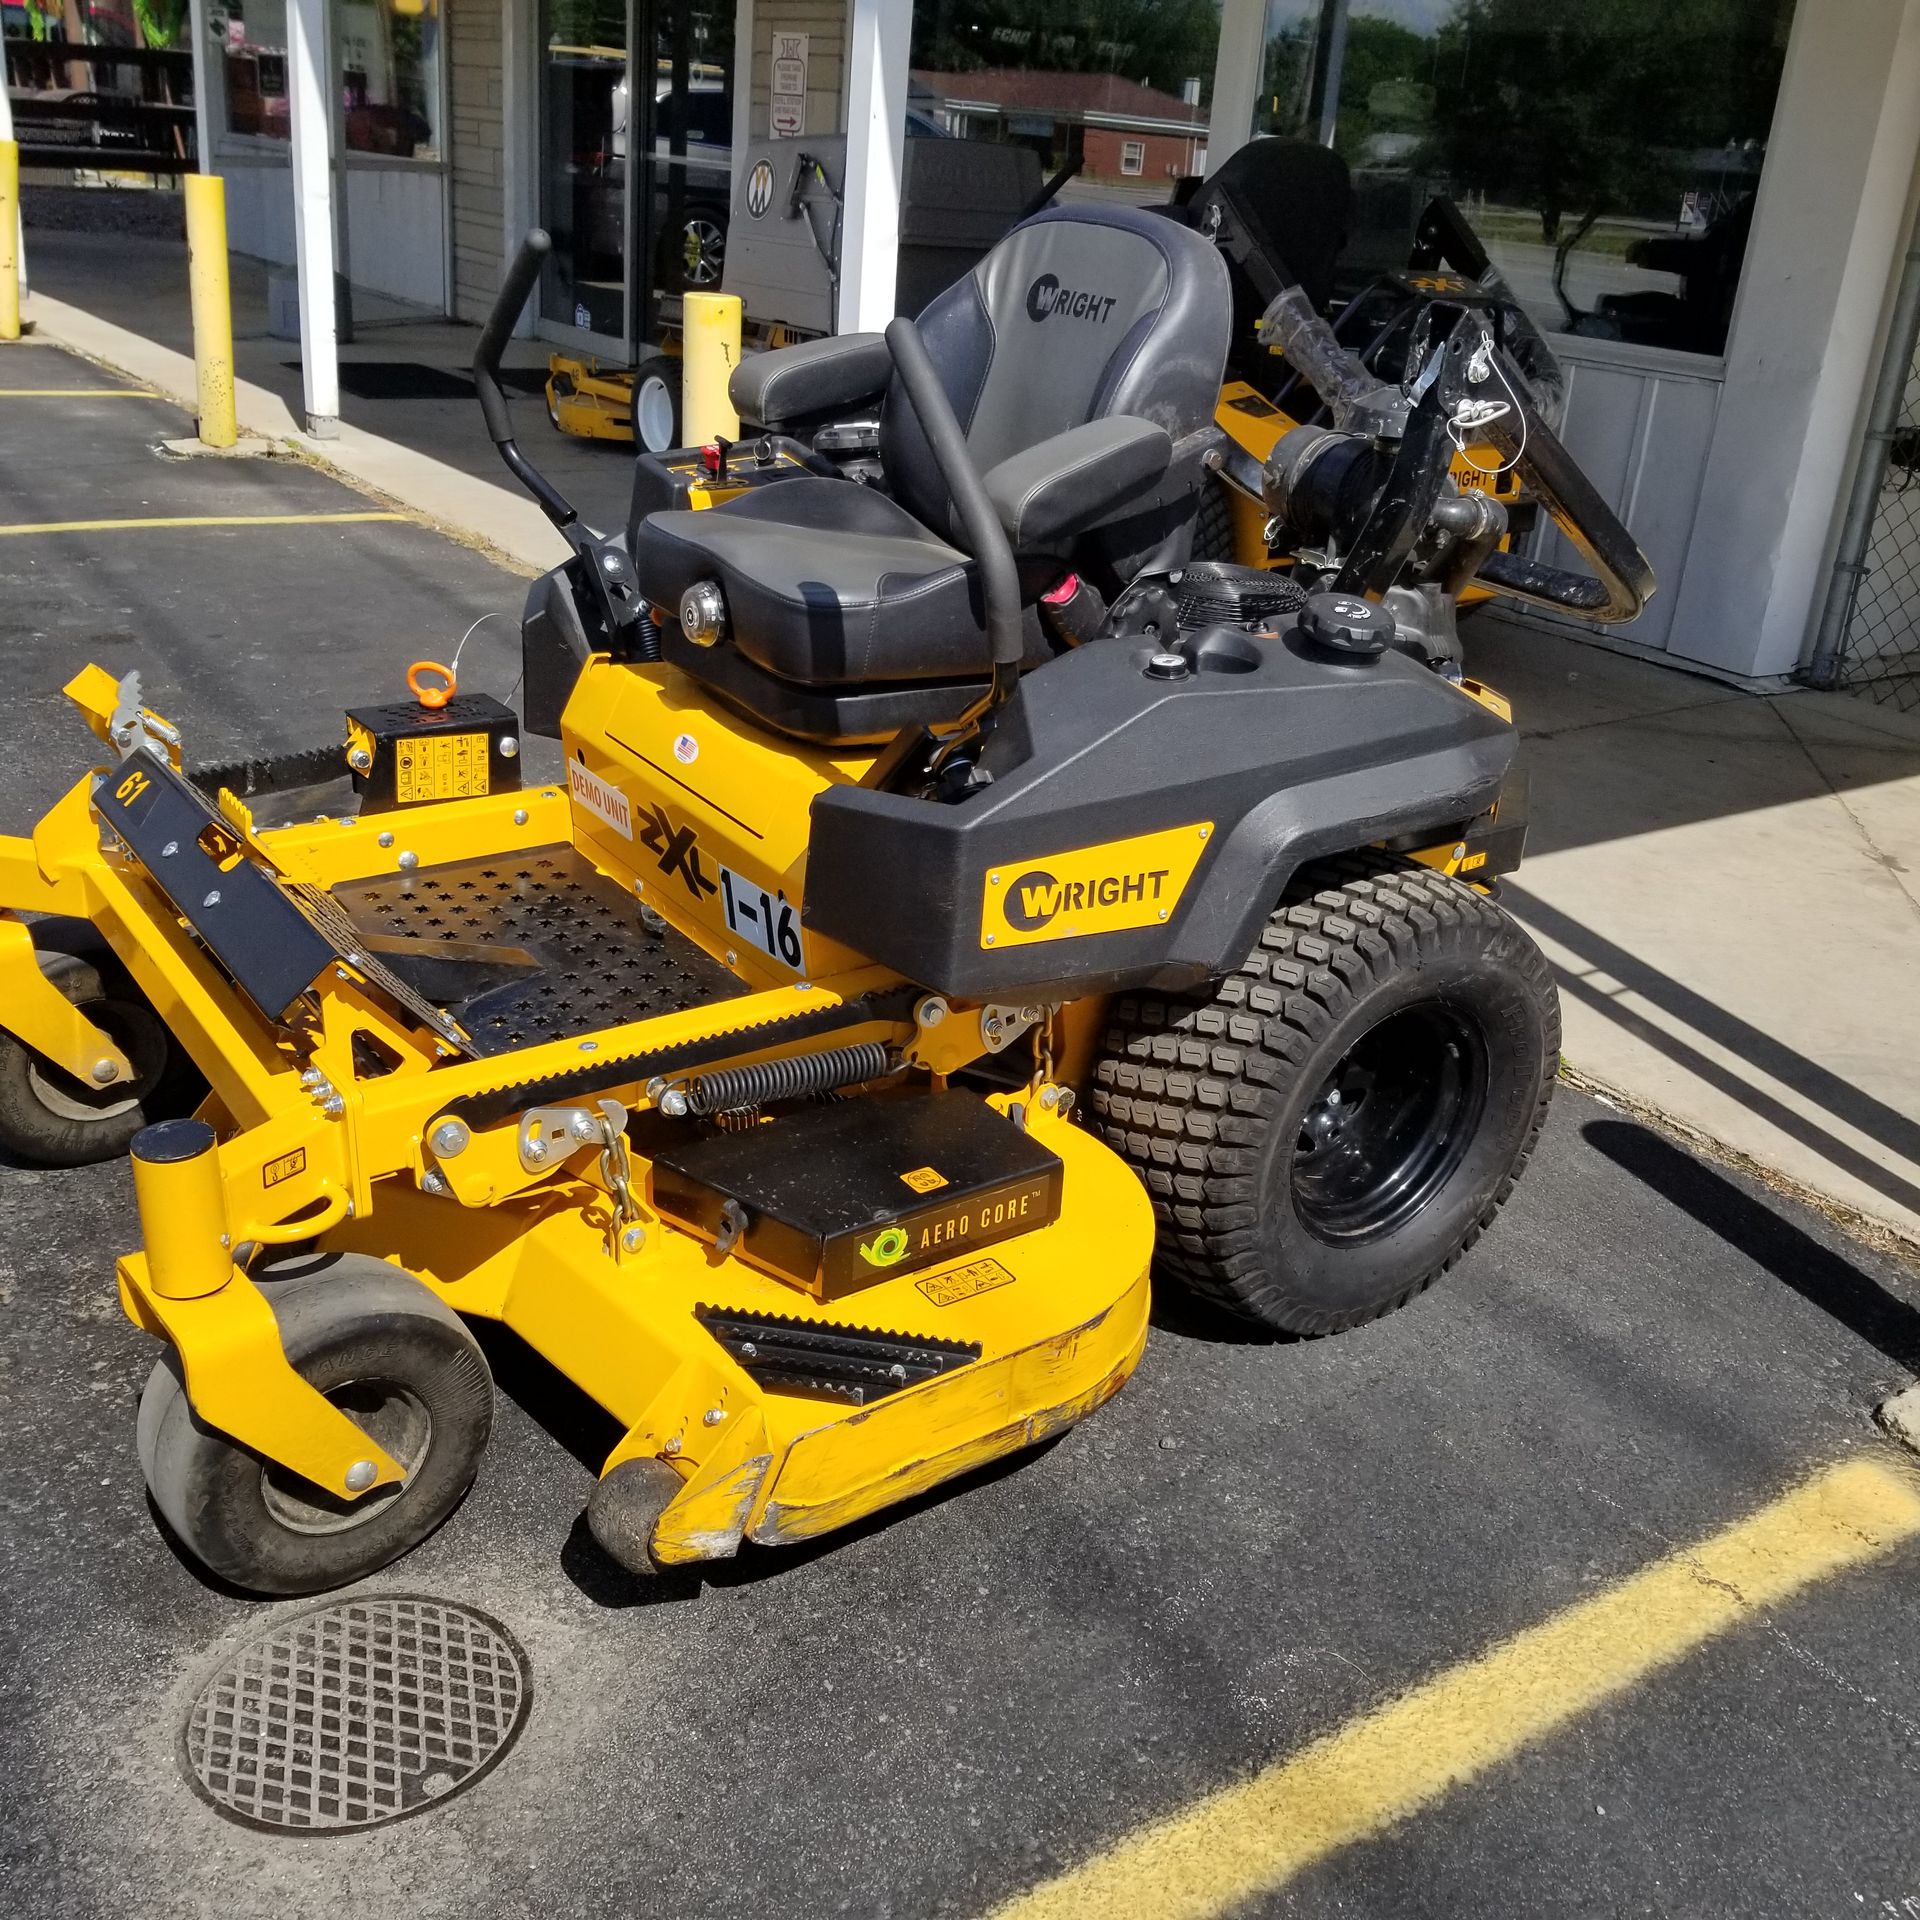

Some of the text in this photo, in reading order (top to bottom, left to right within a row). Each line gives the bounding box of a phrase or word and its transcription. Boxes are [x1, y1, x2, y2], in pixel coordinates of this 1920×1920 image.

[1034, 284, 1117, 323] WRIGHT
[115, 770, 151, 807] 61
[571, 769, 629, 829] DEMO UNIT
[720, 868, 802, 968] 1-16
[1019, 869, 1170, 920] WRIGHT
[920, 1215, 969, 1249] AERO
[980, 1195, 1029, 1229] CORE
